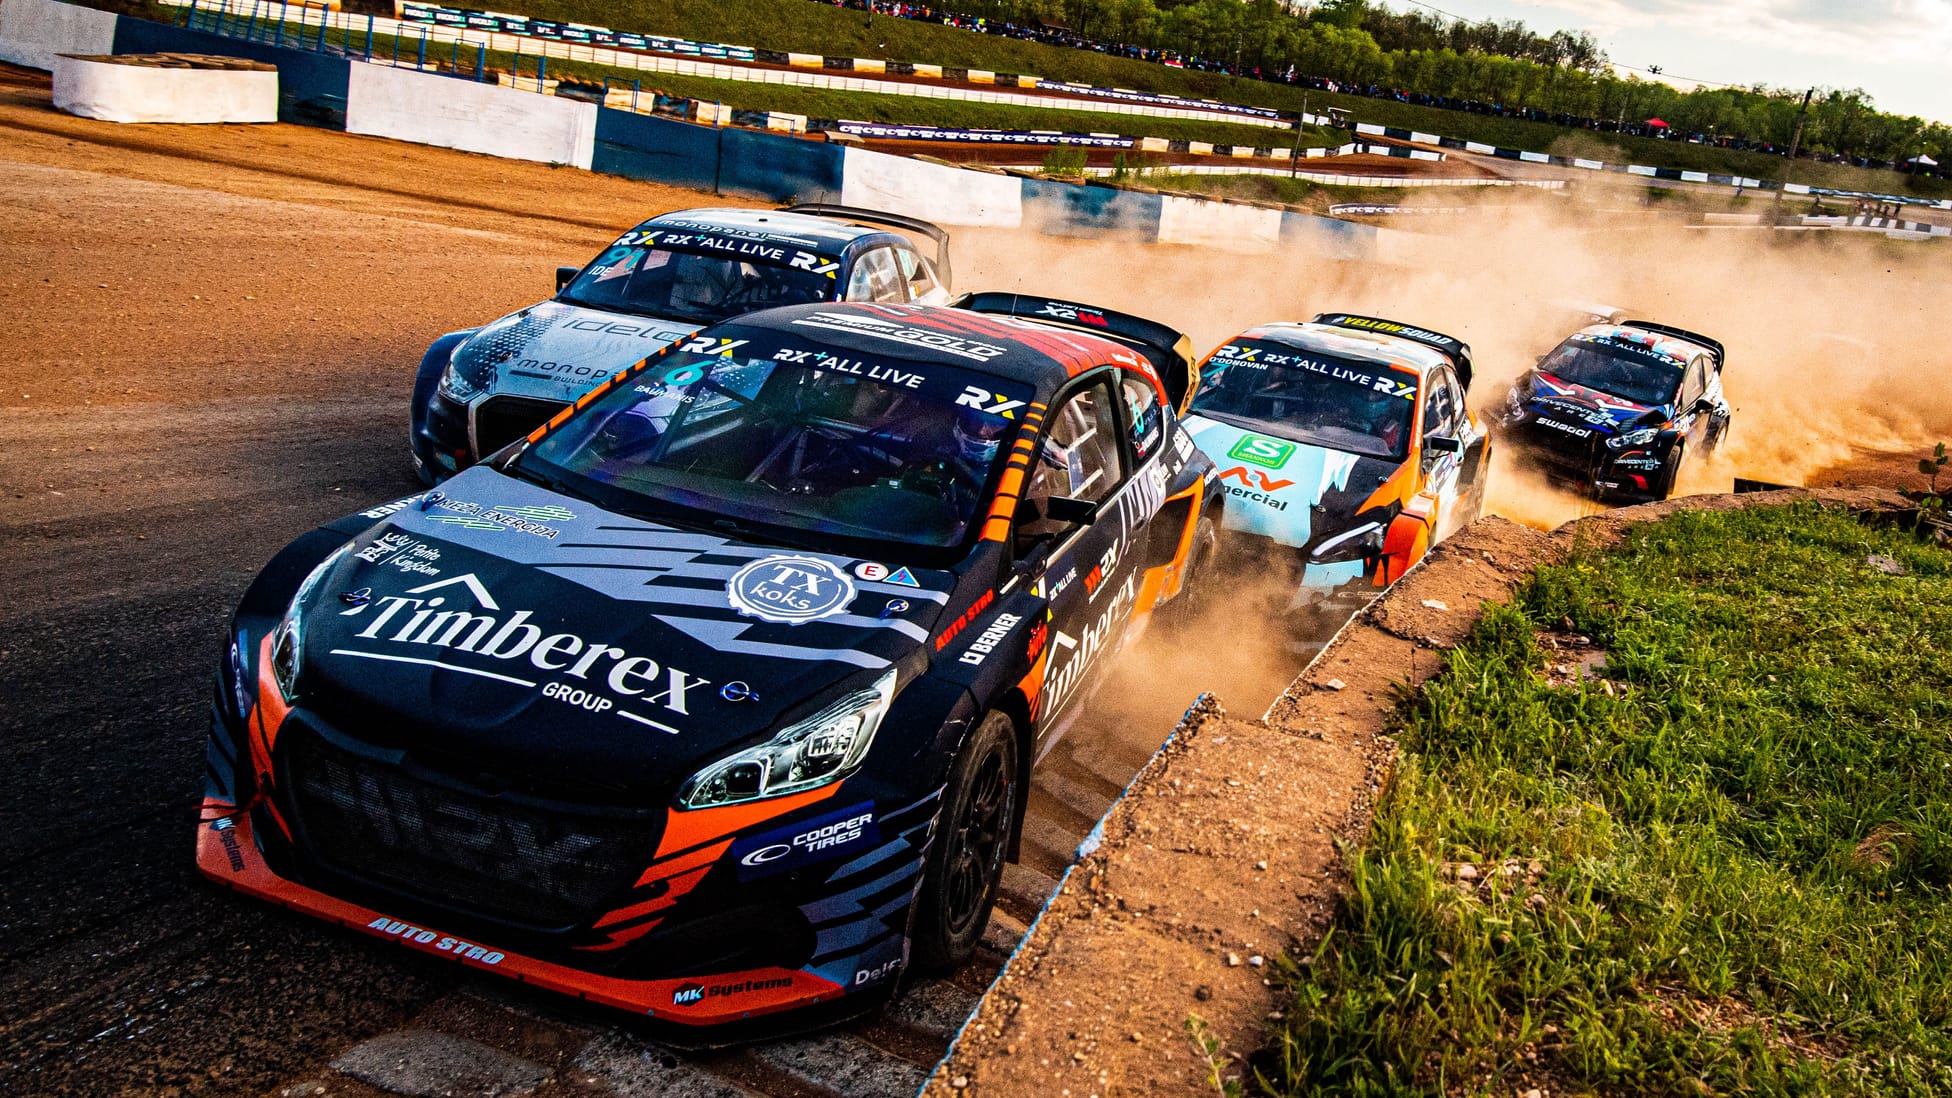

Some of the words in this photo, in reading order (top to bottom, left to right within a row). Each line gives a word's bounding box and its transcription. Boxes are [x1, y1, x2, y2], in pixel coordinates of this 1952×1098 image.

[613, 230, 665, 246] RX
[699, 237, 735, 252] ALL
[740, 244, 785, 261] LIVE
[588, 265, 614, 277] IDE
[789, 250, 841, 281] RX
[806, 316, 897, 335] PREMIUM
[678, 336, 749, 358] RX
[894, 329, 1004, 359] GOLD
[1215, 345, 1263, 362] RX
[1637, 347, 1660, 360] LIVE
[518, 359, 621, 380] monop
[818, 356, 865, 376] ALL
[868, 366, 926, 389] LIVE
[1299, 359, 1329, 375] ALL
[1332, 368, 1372, 386] LIVE
[955, 385, 1027, 420] RX
[1373, 376, 1418, 401] RX
[1223, 485, 1288, 511] mercial
[768, 564, 833, 597] TX
[750, 580, 811, 611] koks
[976, 612, 1023, 655] BERNER
[354, 593, 712, 716] Timberex
[542, 681, 613, 713] GROUP
[793, 813, 873, 846] COOPER
[805, 828, 862, 853] TIRES
[368, 916, 436, 947] AUTO
[434, 935, 506, 966] STRO
[673, 986, 705, 1006] MK
[708, 977, 794, 998] Systems
